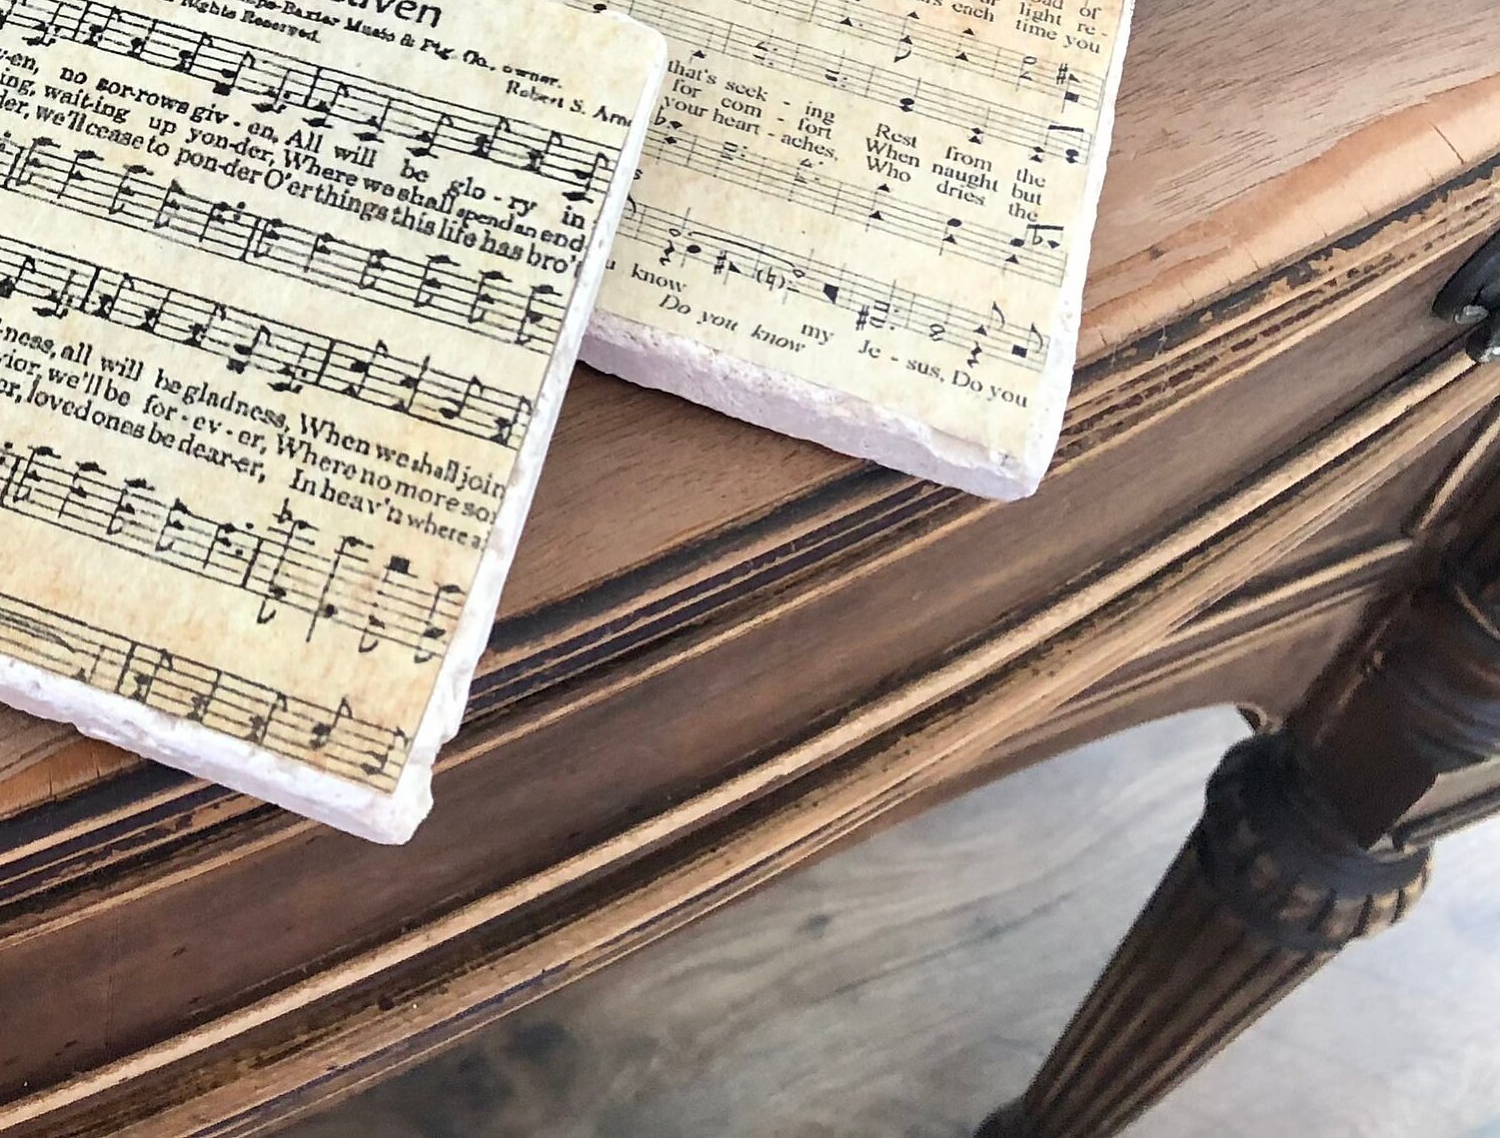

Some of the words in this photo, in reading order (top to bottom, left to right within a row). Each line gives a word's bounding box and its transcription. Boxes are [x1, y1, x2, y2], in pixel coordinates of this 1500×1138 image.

[569, 99, 586, 115] S.
[866, 137, 920, 168] When
[931, 163, 998, 193] naught
[1011, 182, 1042, 206] but
[658, 293, 692, 315] Do
[696, 311, 739, 332] you
[750, 323, 806, 353] know
[60, 341, 93, 367] all
[100, 356, 144, 382] will
[154, 367, 182, 395] be
[181, 381, 290, 434] gladness,
[300, 412, 371, 456] When
[375, 443, 410, 468] we
[410, 451, 460, 484] shall
